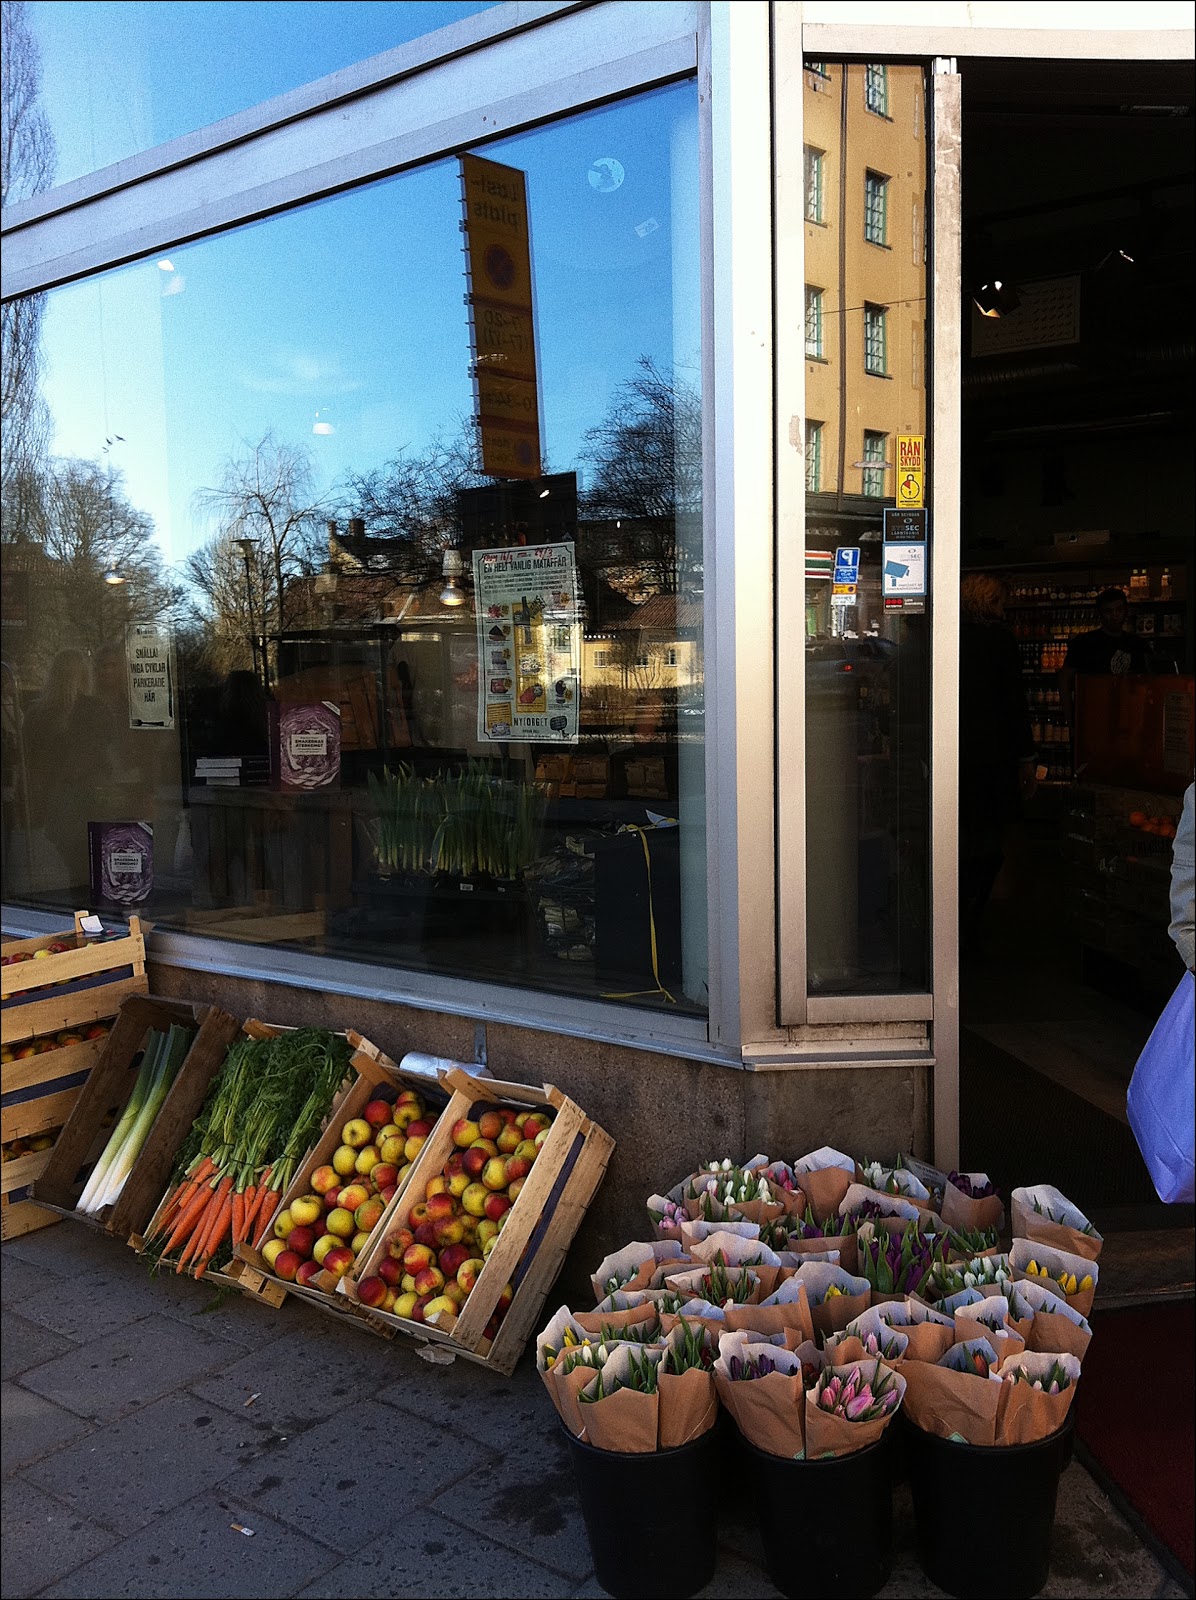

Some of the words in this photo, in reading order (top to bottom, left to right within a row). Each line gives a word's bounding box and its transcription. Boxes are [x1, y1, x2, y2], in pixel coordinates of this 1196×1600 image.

[900, 438, 921, 456] RÅN
[900, 457, 921, 467] SKYDD
[494, 561, 509, 572] HELT
[510, 558, 532, 571] VANLIG
[533, 554, 567, 569] MATAFFÄR
[145, 662, 166, 673] CYKLAR
[133, 677, 165, 688] PARKERADE
[144, 690, 156, 702] HÄR
[513, 717, 548, 726] NYTORGET
